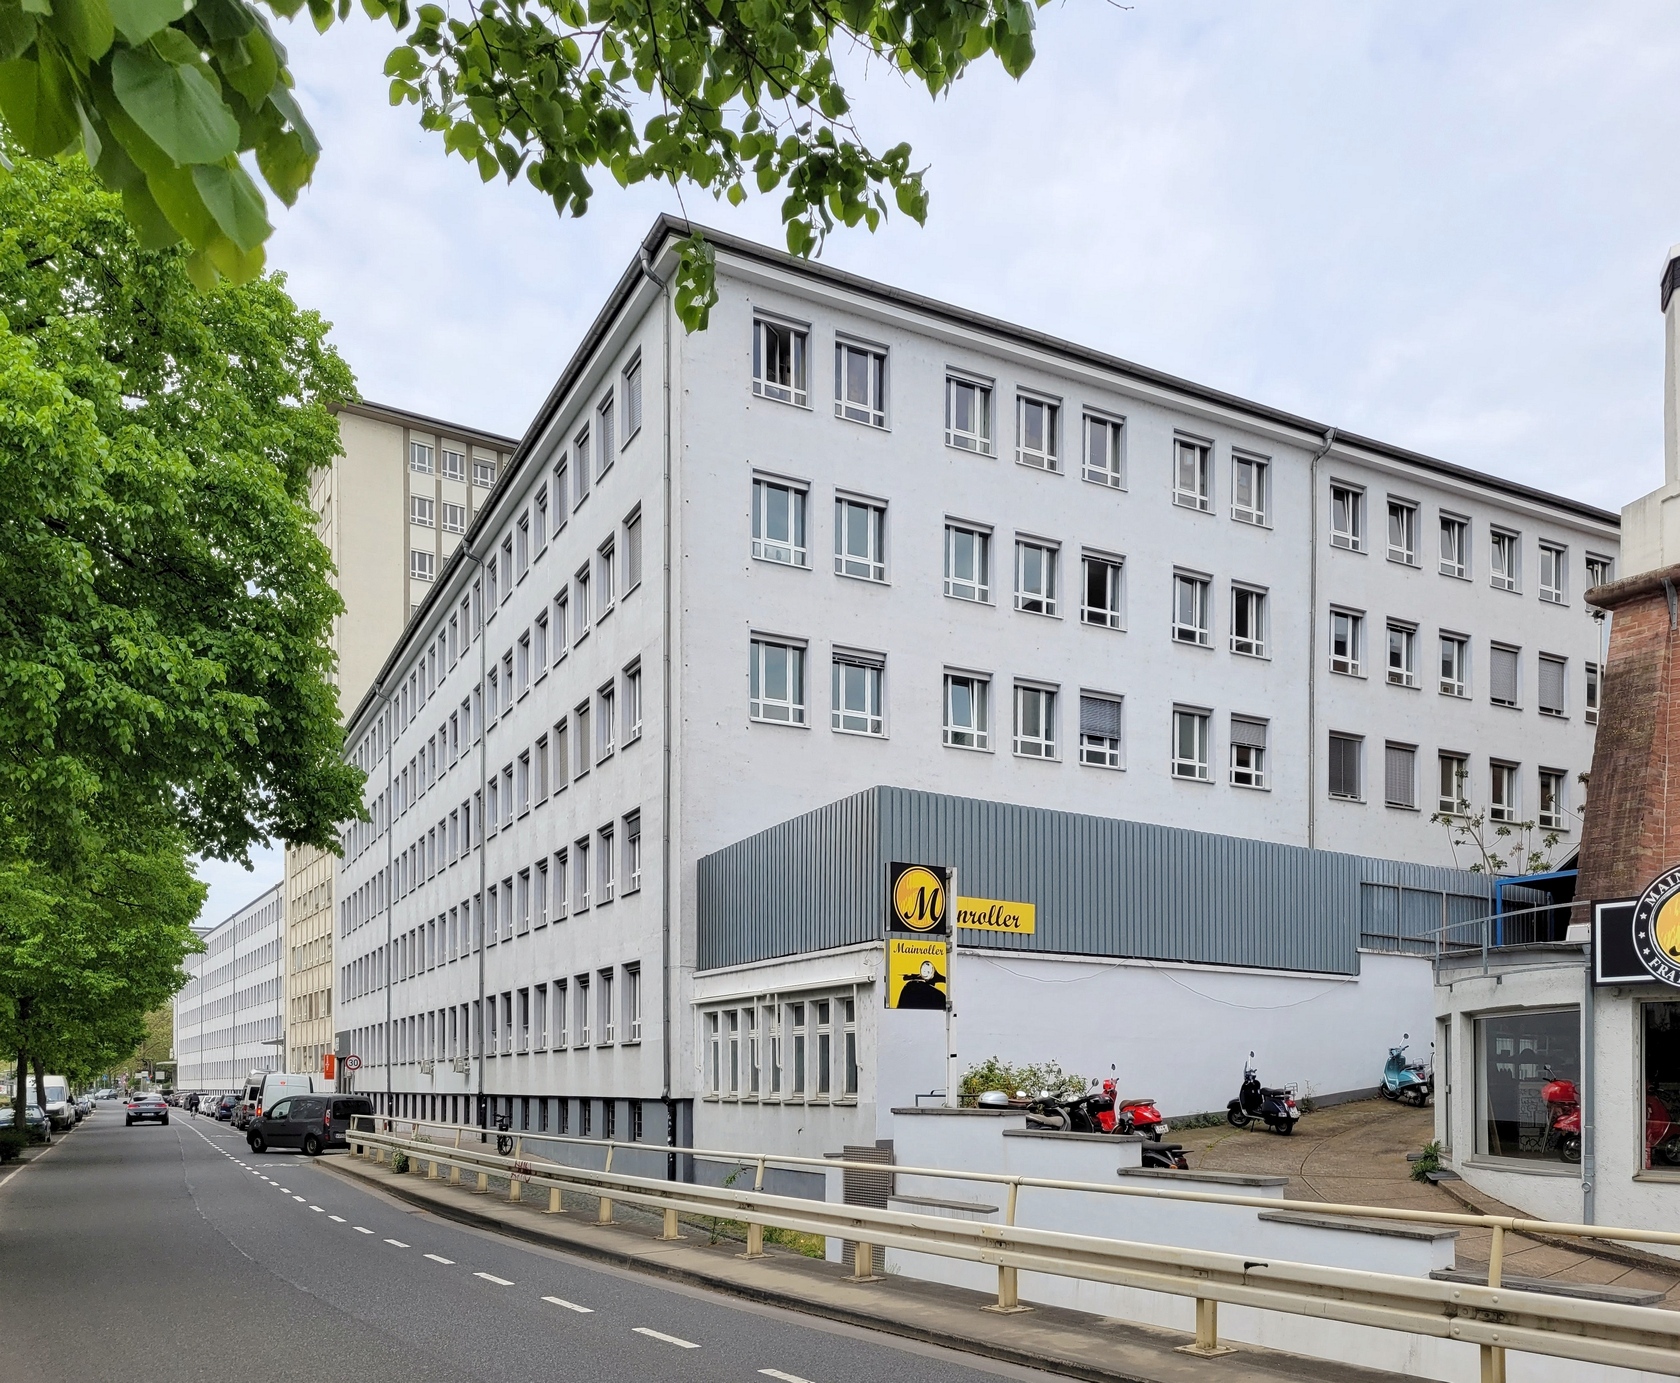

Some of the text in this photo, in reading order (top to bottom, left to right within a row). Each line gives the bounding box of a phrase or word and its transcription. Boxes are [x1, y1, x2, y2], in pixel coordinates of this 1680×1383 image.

[904, 886, 940, 922] M
[957, 904, 1021, 928] nroller
[893, 942, 944, 956] Mainroller
[348, 1058, 359, 1067] 30
